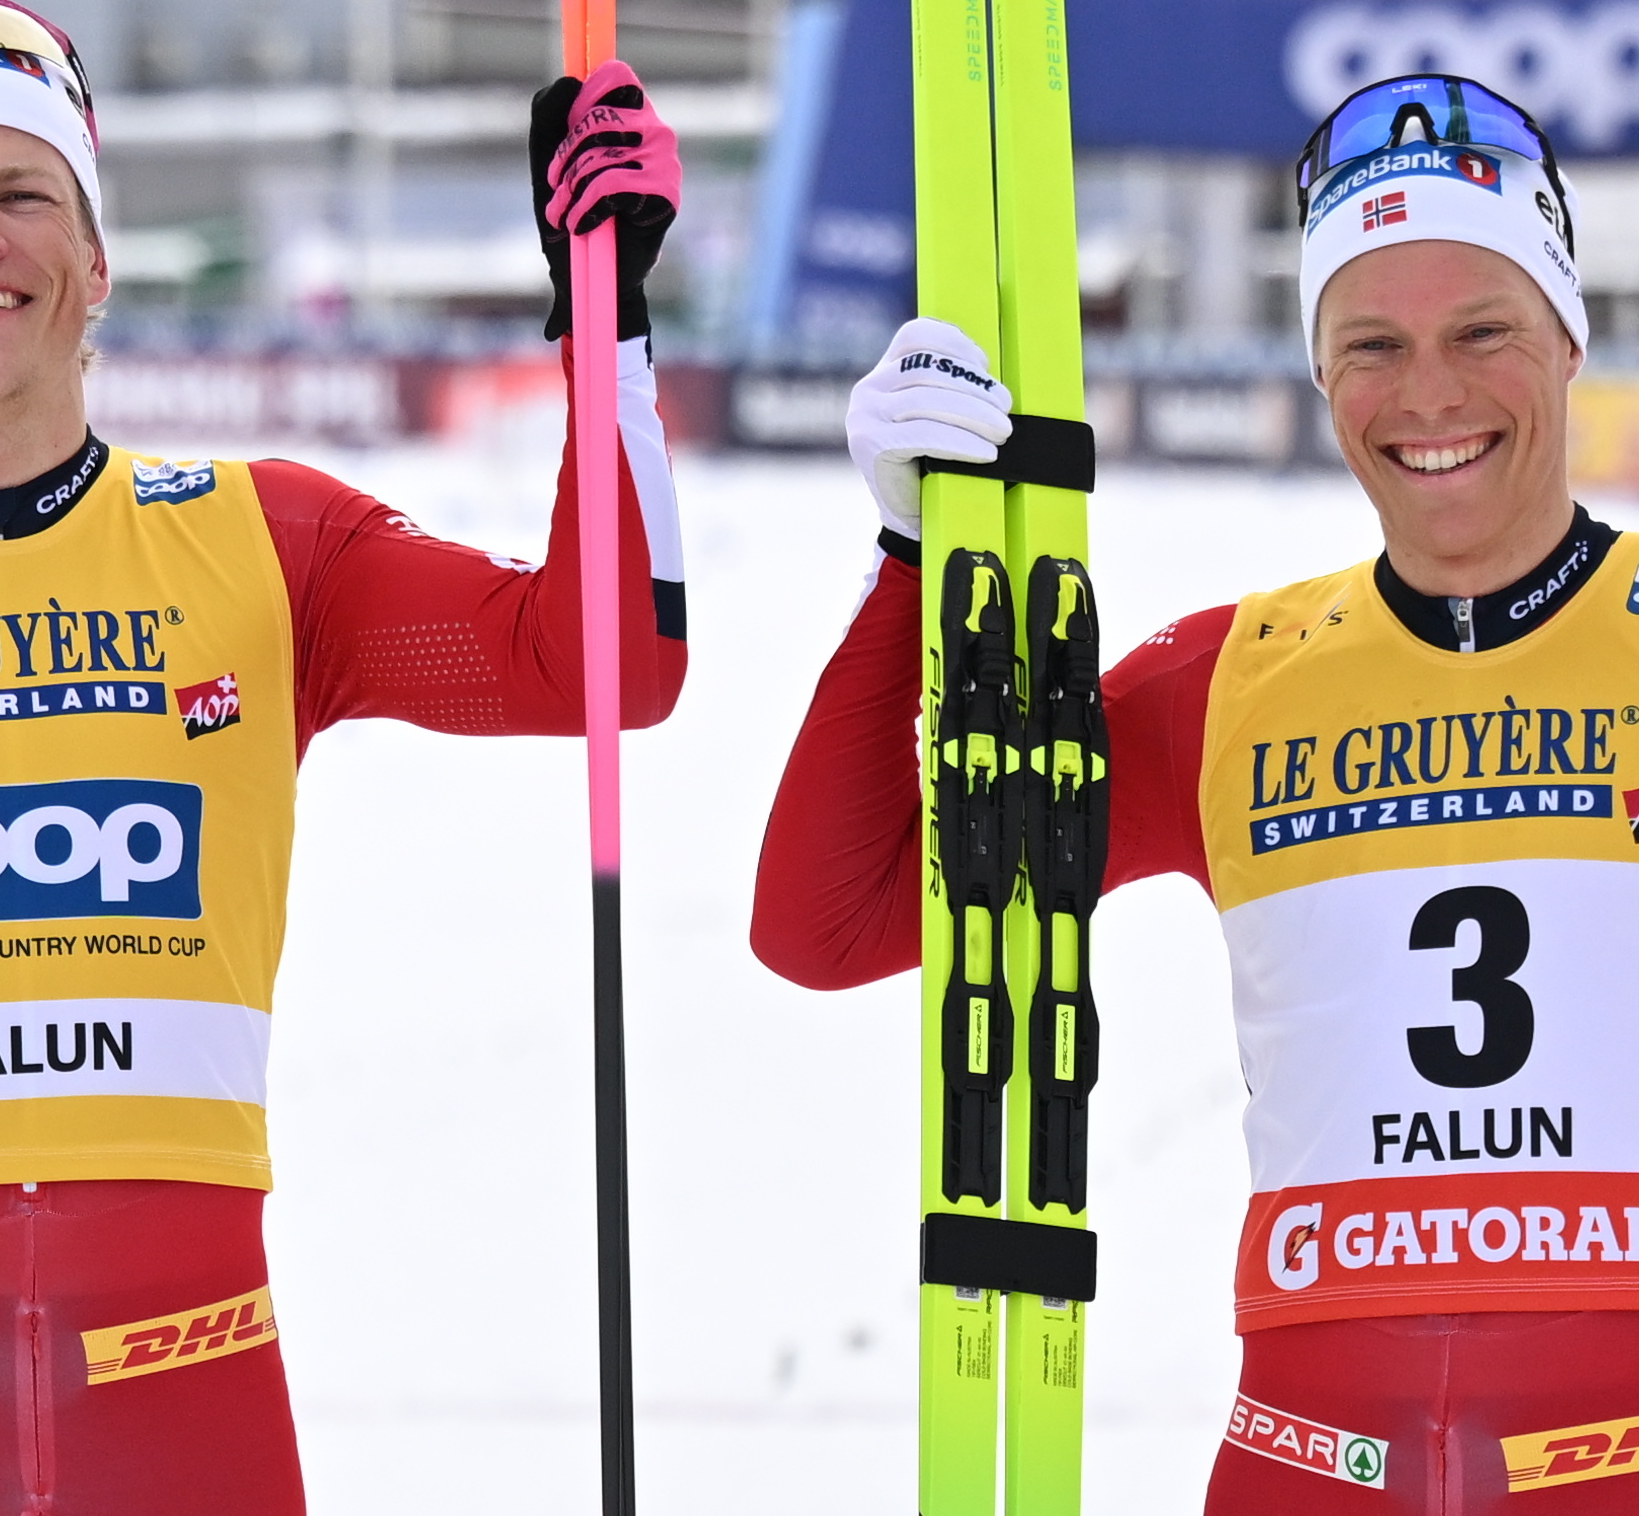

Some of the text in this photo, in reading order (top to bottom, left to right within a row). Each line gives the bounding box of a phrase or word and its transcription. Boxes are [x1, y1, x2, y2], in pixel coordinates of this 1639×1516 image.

[1392, 83, 1427, 94] LEKI
[1543, 240, 1577, 288] CRAFT
[35, 446, 98, 516] CRAFT
[1509, 548, 1581, 621] CRAFT
[1251, 734, 1318, 811] LE
[1263, 786, 1595, 847] SWITZERLAND
[84, 934, 163, 959] WORLD
[169, 937, 207, 959] CUP
[1406, 885, 1535, 1089] 3
[1371, 1106, 1573, 1166] FALUN
[1267, 1202, 1323, 1291] G
[121, 1299, 267, 1368] DHL
[1230, 1403, 1335, 1466] SPAR
